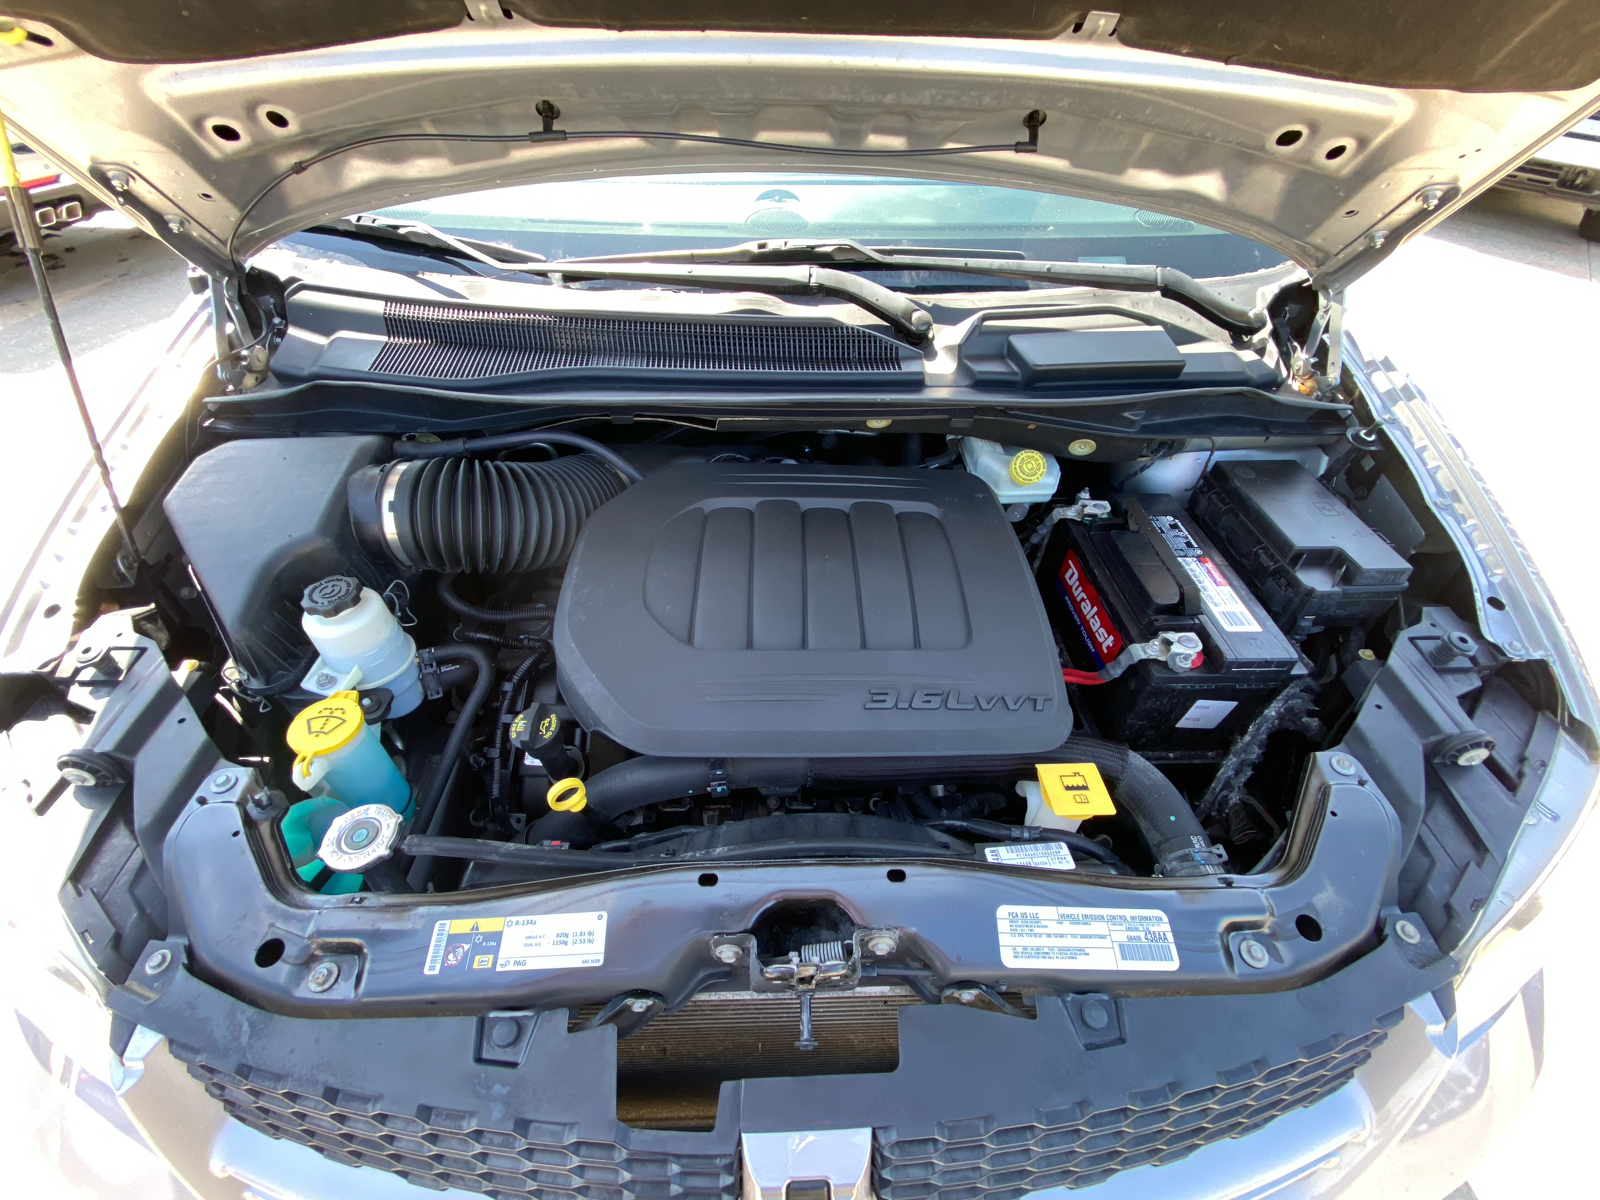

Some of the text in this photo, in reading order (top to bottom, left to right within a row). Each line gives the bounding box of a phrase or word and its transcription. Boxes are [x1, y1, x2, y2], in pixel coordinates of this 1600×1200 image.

[1064, 559, 1115, 654] Duralast
[1064, 595, 1096, 653] PROVEN TOUGH
[543, 731, 553, 739] OIL
[514, 919, 537, 927] R-134a
[572, 930, 586, 939] (1.81
[586, 930, 595, 939] lb)
[1144, 931, 1170, 943] 438AA
[572, 938, 586, 946] (2.53
[586, 938, 594, 946] lb)
[512, 959, 527, 967] PAG
